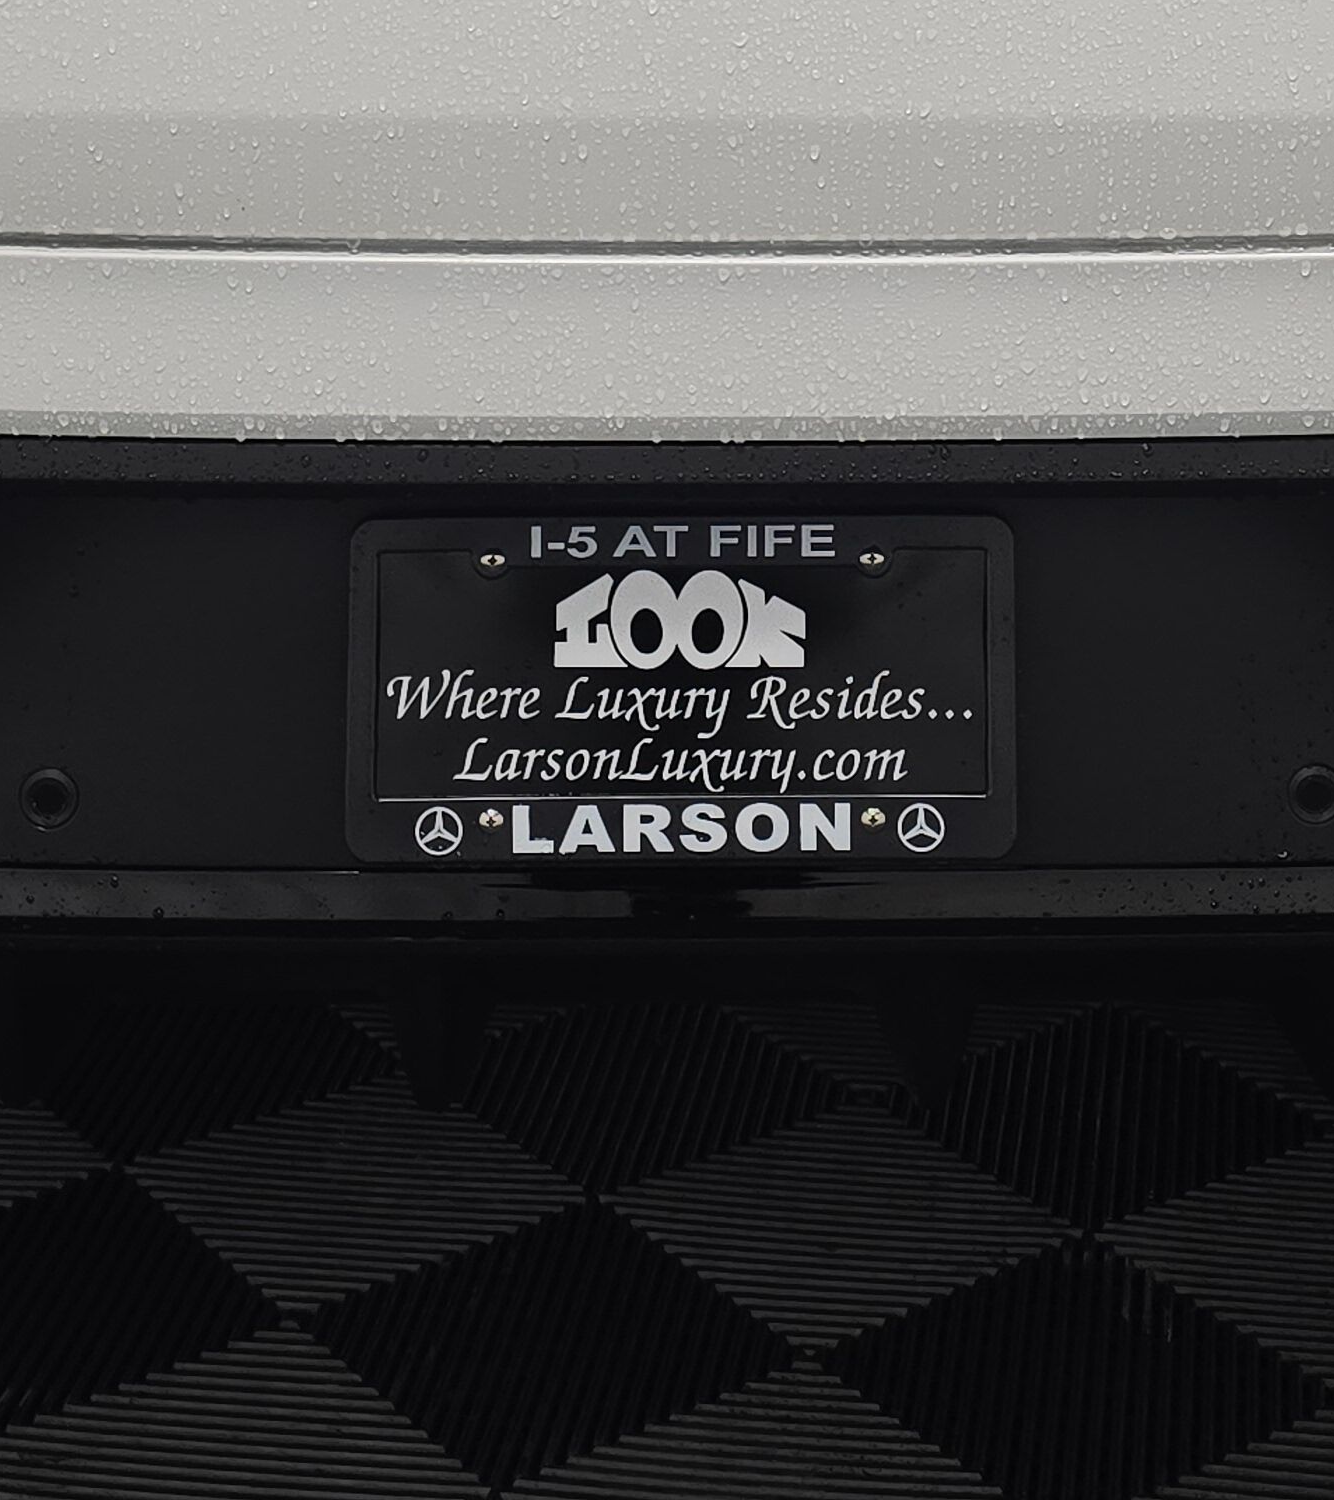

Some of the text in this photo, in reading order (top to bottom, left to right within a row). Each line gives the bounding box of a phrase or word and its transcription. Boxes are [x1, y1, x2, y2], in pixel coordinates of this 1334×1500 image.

[530, 524, 836, 559] I-5 AT FIFE
[386, 669, 974, 739] Where Luxury Resides...
[452, 737, 908, 794] LarsonLuxury.com
[511, 802, 852, 855] LARSON
